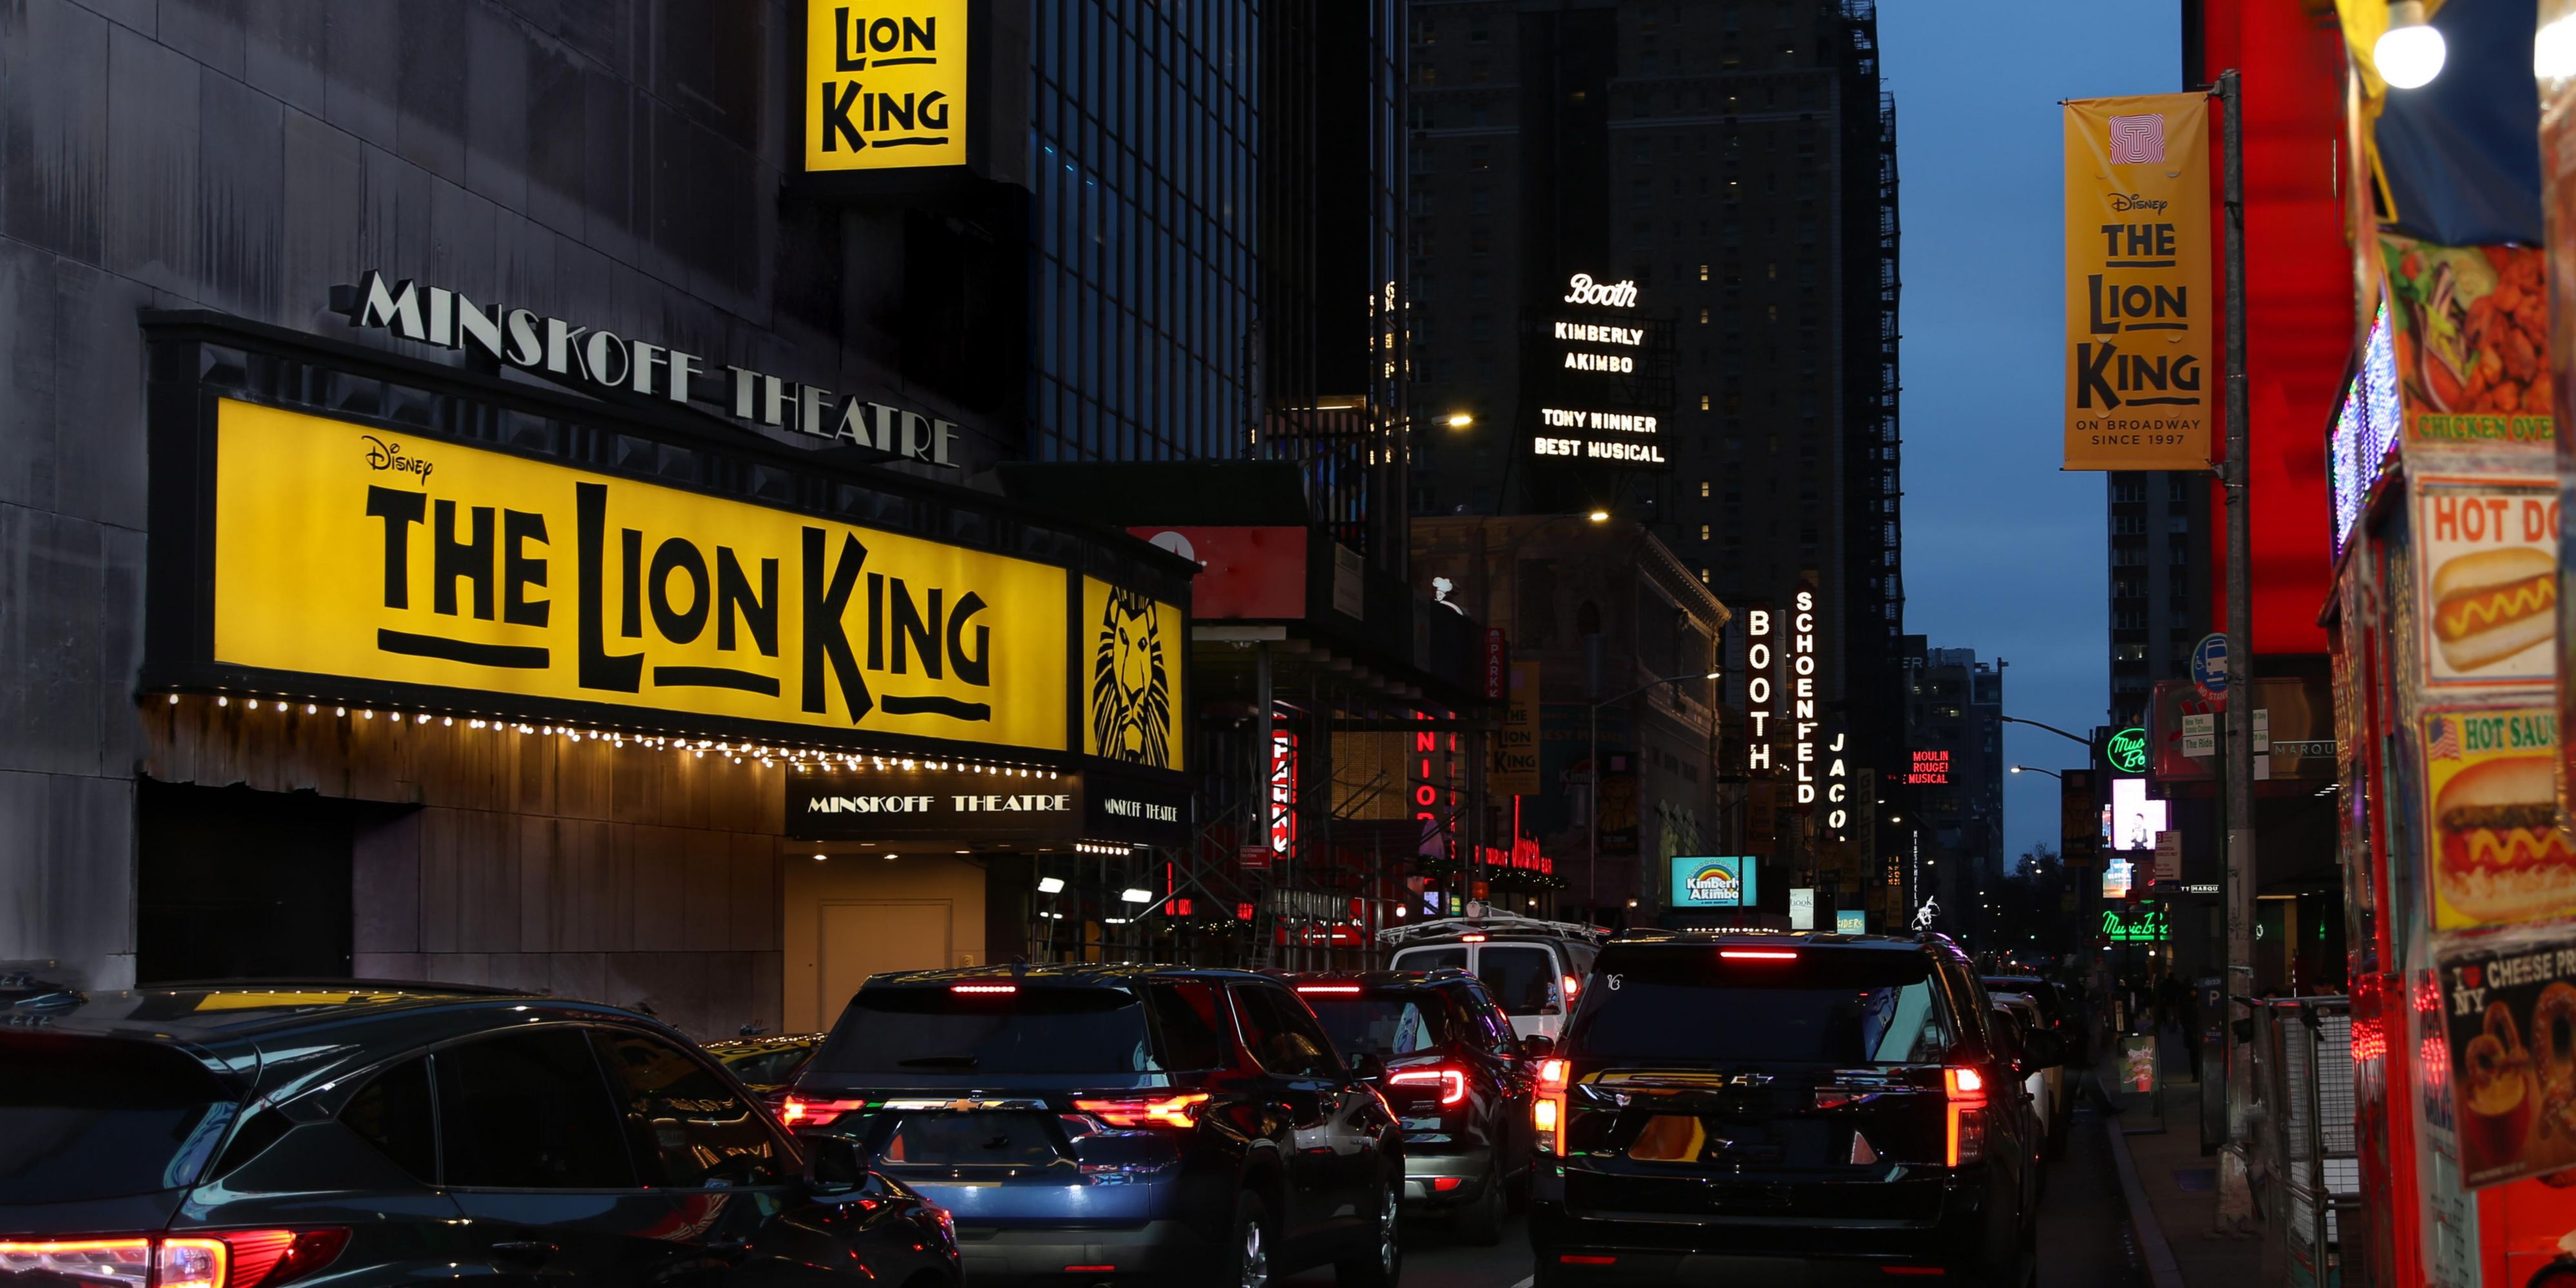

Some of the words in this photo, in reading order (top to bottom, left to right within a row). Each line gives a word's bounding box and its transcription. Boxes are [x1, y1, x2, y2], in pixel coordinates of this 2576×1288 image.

[835, 6, 936, 72] LION
[822, 80, 949, 153] KING
[2101, 223, 2176, 256] THE
[1564, 273, 1638, 307] Booth
[2088, 274, 2187, 334] LION
[1555, 322, 1643, 345] KIMBERLY
[358, 269, 704, 404] MINSKOFF
[723, 363, 961, 469] THEATRE
[1565, 352, 1633, 373] AKIMBO
[2077, 342, 2200, 411] KING
[1542, 408, 1586, 428] TONY
[1591, 412, 1656, 433] WINNER
[2076, 421, 2099, 430] ON
[2107, 420, 2201, 430] BROADWAY
[2418, 414, 2507, 439] CHICKEN
[1535, 437, 1581, 456] BEST
[1588, 441, 1665, 462] MUSICAL
[2092, 435, 2140, 445] SINCE
[2148, 435, 2184, 444] 1997
[2434, 495, 2509, 543] HOT
[2523, 499, 2561, 543] DO
[366, 484, 550, 628] THE
[576, 481, 779, 694] LION
[801, 526, 990, 725] KING
[1490, 645, 1499, 686] PARK
[1749, 610, 1770, 769] BOOTH
[1795, 591, 1815, 803] SCHOENFELD
[2197, 685, 2208, 698] NO
[2114, 736, 2145, 753] Mus
[2186, 740, 2197, 748] The
[2199, 738, 2213, 747] Ride
[2465, 717, 2505, 750] HOT
[1913, 750, 1948, 761] MOULIN
[2123, 749, 2145, 768] Bo
[2275, 743, 2334, 755] MARQU
[1909, 773, 1948, 784] MUSICAL
[1913, 762, 1948, 772] ROUGE!
[1828, 733, 1847, 842] JACO
[808, 795, 934, 813] MINSKOFF
[951, 795, 1070, 811] THEATRE
[1104, 797, 1143, 818] MINSKOFF
[1146, 803, 1178, 822] THEATRE
[2103, 910, 2142, 934] Muic
[2487, 952, 2553, 990] CHEESE
[2556, 948, 2576, 978] PR
[2451, 987, 2486, 1016] NY
